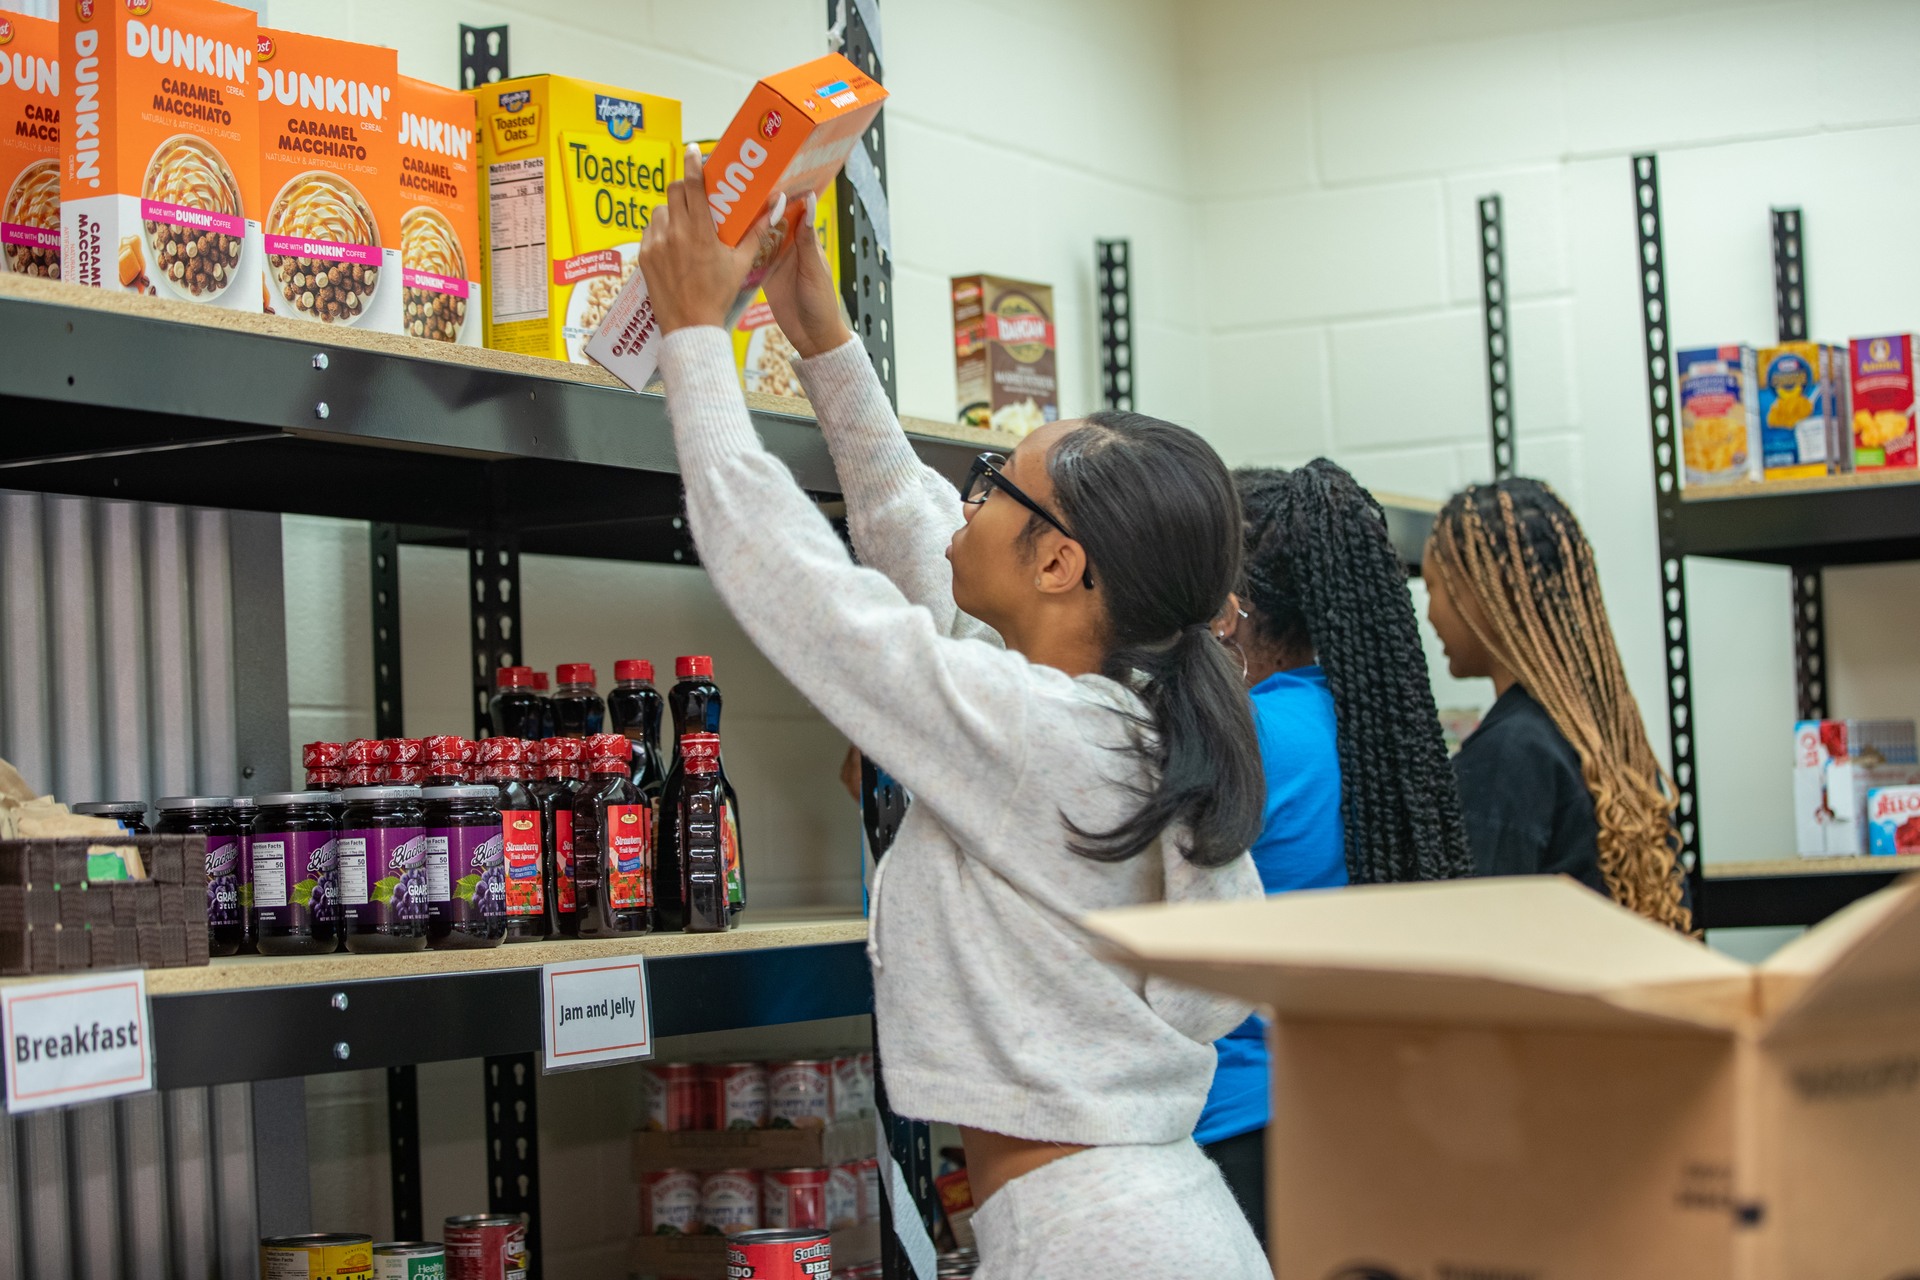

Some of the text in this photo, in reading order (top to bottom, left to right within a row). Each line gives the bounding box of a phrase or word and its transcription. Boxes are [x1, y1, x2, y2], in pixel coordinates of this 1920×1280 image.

[126, 19, 252, 84] DUNKIN'
[161, 77, 224, 106] CARAMEL
[226, 85, 246, 98] CEREAL
[25, 104, 60, 124] CARA
[75, 29, 100, 188] DUNKIN'
[153, 94, 231, 126] MACCHIATO
[142, 111, 171, 127] NATURALLY
[360, 121, 383, 133] CEREAL
[495, 112, 535, 131] Toasted
[287, 118, 358, 142] CARAMEL
[504, 129, 528, 141] Oats
[278, 134, 367, 161] MACCHIATO
[265, 152, 301, 165] NATURALLY
[402, 156, 451, 181] CARAMEL
[489, 158, 544, 173] Nutrition Facts
[569, 141, 665, 193] Toasted
[149, 207, 232, 229] MADE WITH DUNKIN' COFFEE
[595, 188, 649, 230] Oats
[79, 213, 89, 287] MACCHI
[90, 222, 101, 288] CARAME
[273, 241, 367, 259] MADE WITH DUNKIN' COFFEE
[565, 256, 581, 270] Good
[506, 841, 539, 853] Strawberry
[357, 858, 366, 866] 50
[439, 856, 448, 864] 50
[216, 890, 237, 902] GRAPE
[560, 997, 636, 1026] Jam and Jelly
[16, 1021, 138, 1063] Breakfast
[418, 1262, 443, 1276] Healthy
